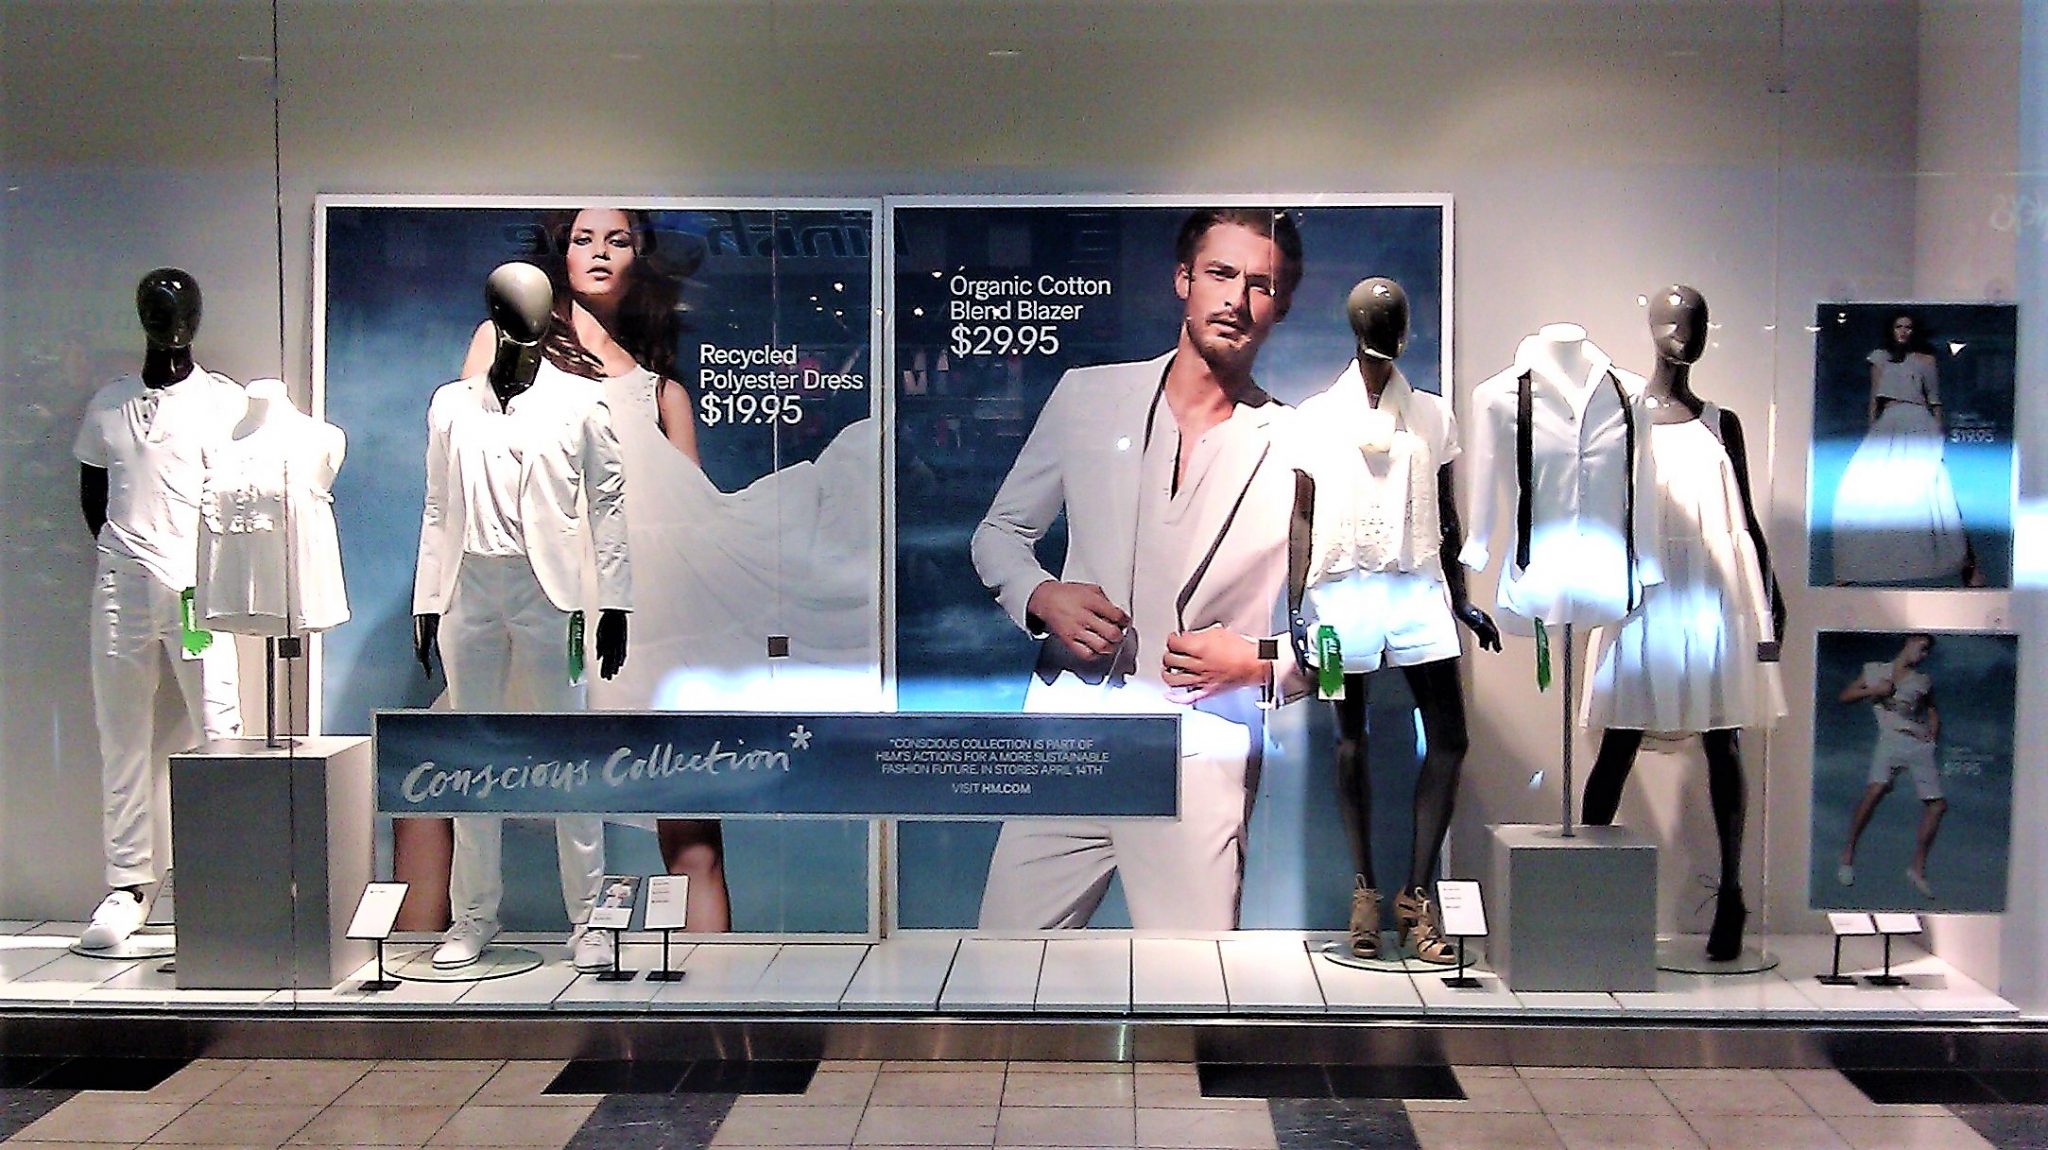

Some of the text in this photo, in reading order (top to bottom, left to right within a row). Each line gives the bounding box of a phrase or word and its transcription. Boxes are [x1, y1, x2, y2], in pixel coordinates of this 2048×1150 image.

[950, 275, 1112, 301] Organic Cotton
[950, 300, 1084, 320] Blend Blazer
[950, 323, 1060, 359] $29.95
[700, 343, 798, 370] Recycled
[700, 369, 864, 395] Polyester Dress
[700, 391, 803, 427] $19.95
[912, 751, 962, 762] ACTIONS
[964, 751, 987, 762] FOR
[988, 751, 998, 762] A
[999, 751, 1033, 762] MORE
[1033, 751, 1110, 763] SUSTAINABLE
[961, 738, 1032, 750] COLLECTION
[1034, 739, 1044, 750] IS
[1046, 739, 1076, 750] PART
[1077, 739, 1094, 750] OF
[402, 755, 591, 804] Conscious
[882, 763, 930, 774] FASHION
[981, 763, 993, 774] IN
[994, 763, 1039, 775] STORES
[1041, 763, 1073, 776] APRIL
[1075, 764, 1104, 775] 14TH
[952, 782, 1032, 795] VISIT HM.COM
